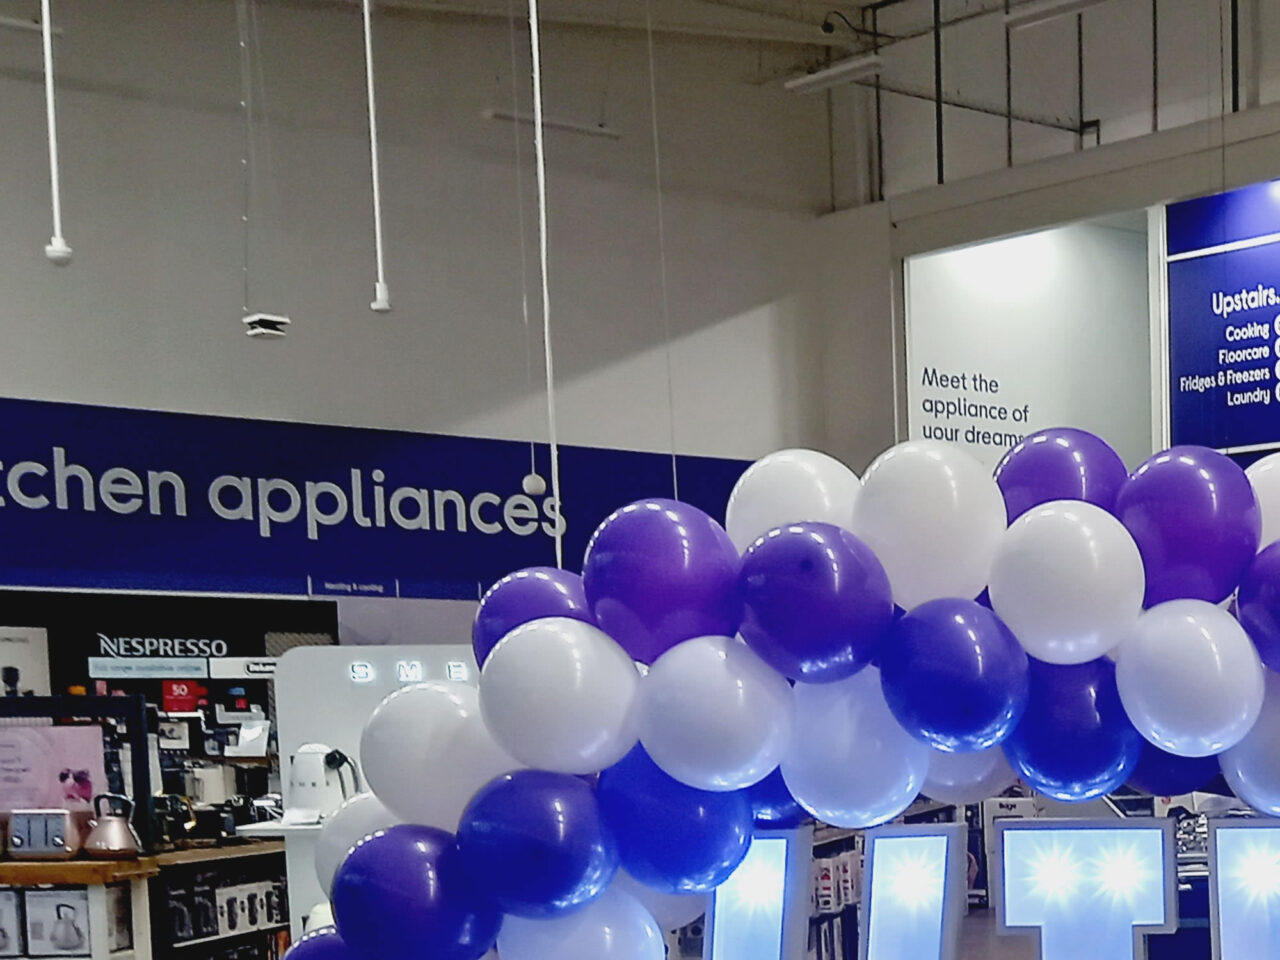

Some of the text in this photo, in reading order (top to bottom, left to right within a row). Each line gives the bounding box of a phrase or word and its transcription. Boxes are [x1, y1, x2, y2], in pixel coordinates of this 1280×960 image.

[1225, 322, 1270, 341] Cooking
[1219, 345, 1270, 364] Floorcare
[922, 367, 999, 393] Meet the
[1180, 367, 1270, 392] Fridges & Freezers
[1227, 387, 1270, 406] Laundry
[922, 397, 1029, 422] appliance of
[964, 425, 1025, 447] dream
[0, 446, 566, 540] chen appliances
[97, 632, 228, 658] NESPRESSO
[350, 660, 469, 682] SME
